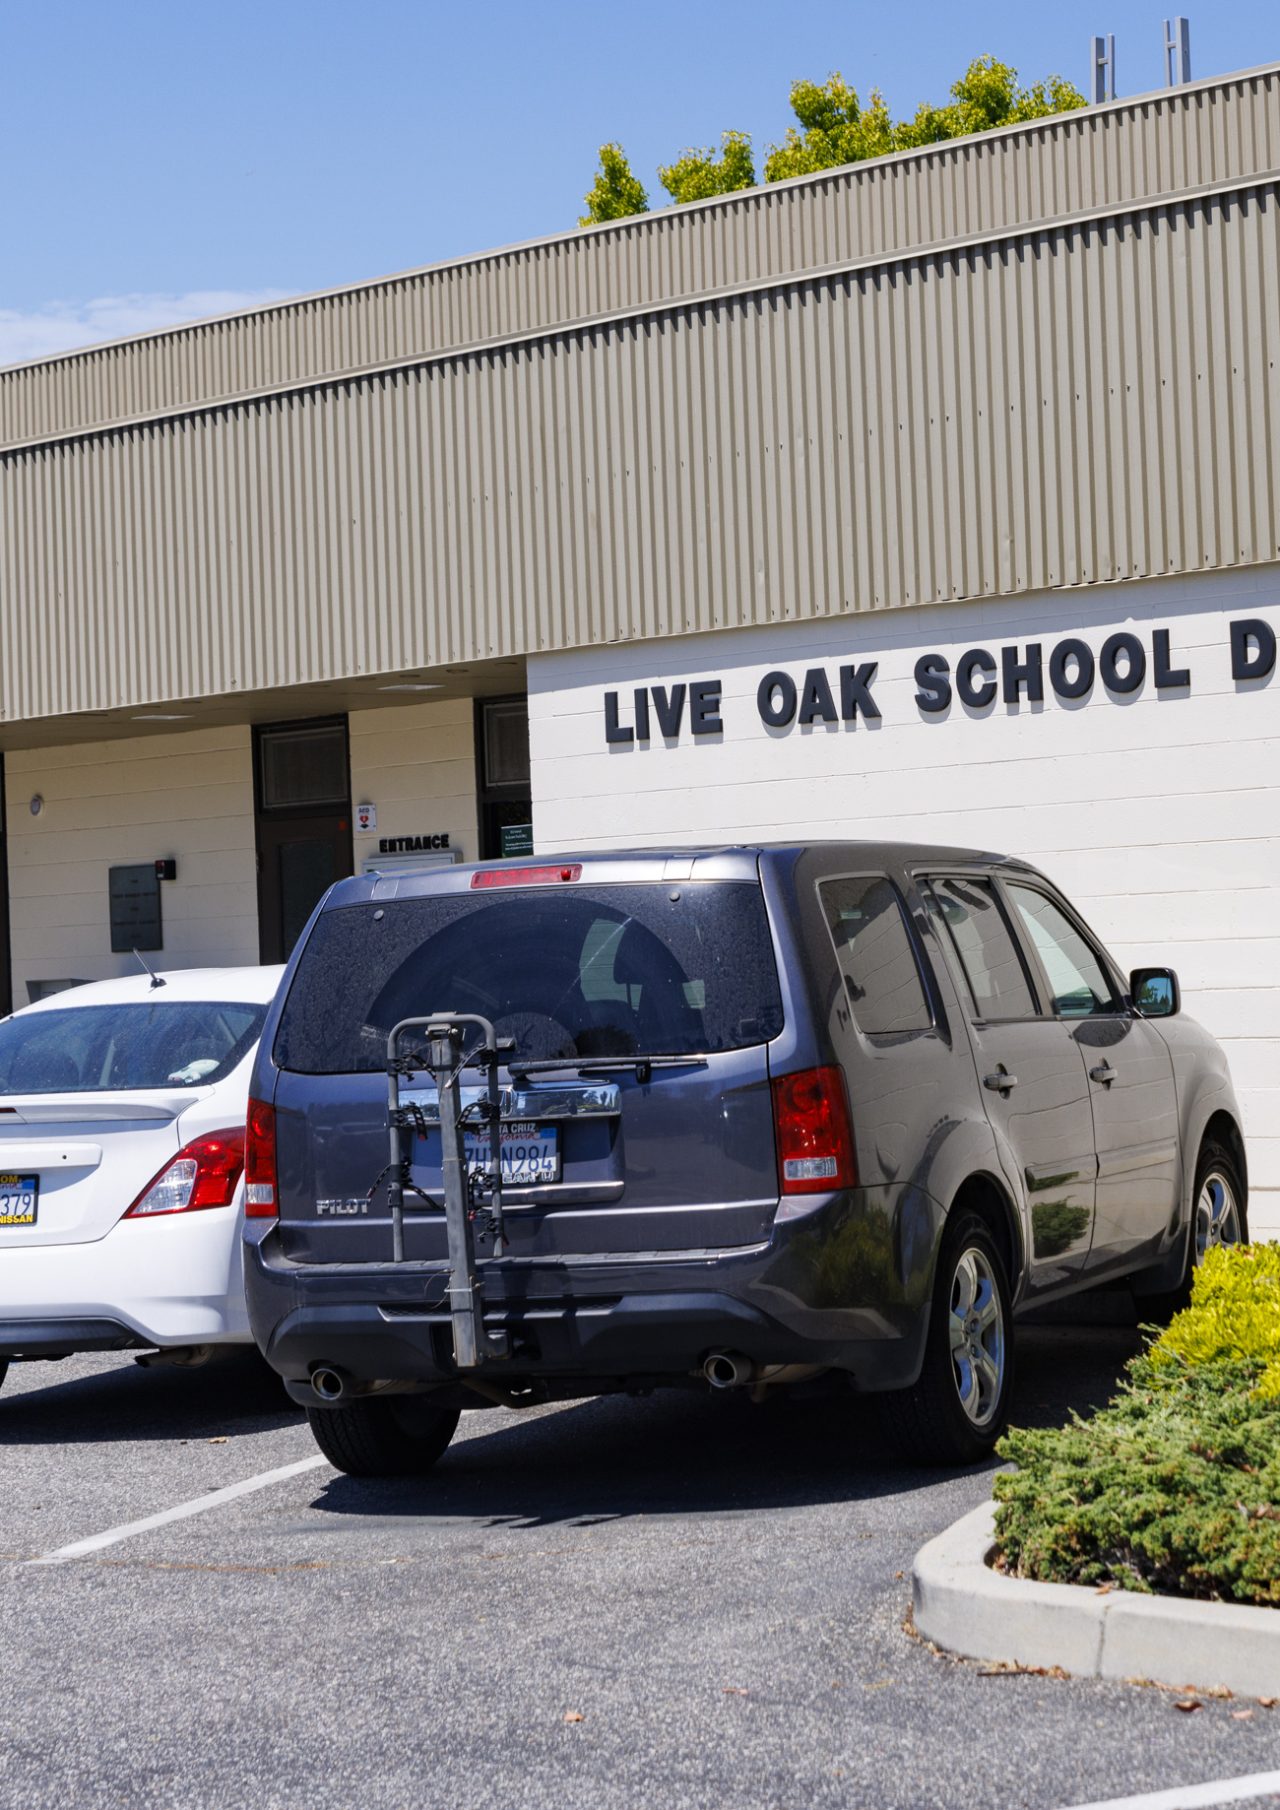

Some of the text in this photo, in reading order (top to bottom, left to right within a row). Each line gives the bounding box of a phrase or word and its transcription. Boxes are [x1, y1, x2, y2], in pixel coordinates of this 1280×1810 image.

[604, 678, 724, 744] LIVE
[756, 661, 882, 728] OAK
[914, 627, 1191, 713] SCHOOL
[379, 833, 450, 853] ENTRANCE
[479, 1122, 537, 1135] SATA CRUZ
[465, 1145, 552, 1173] 7HN984
[316, 1198, 371, 1215] PILOT
